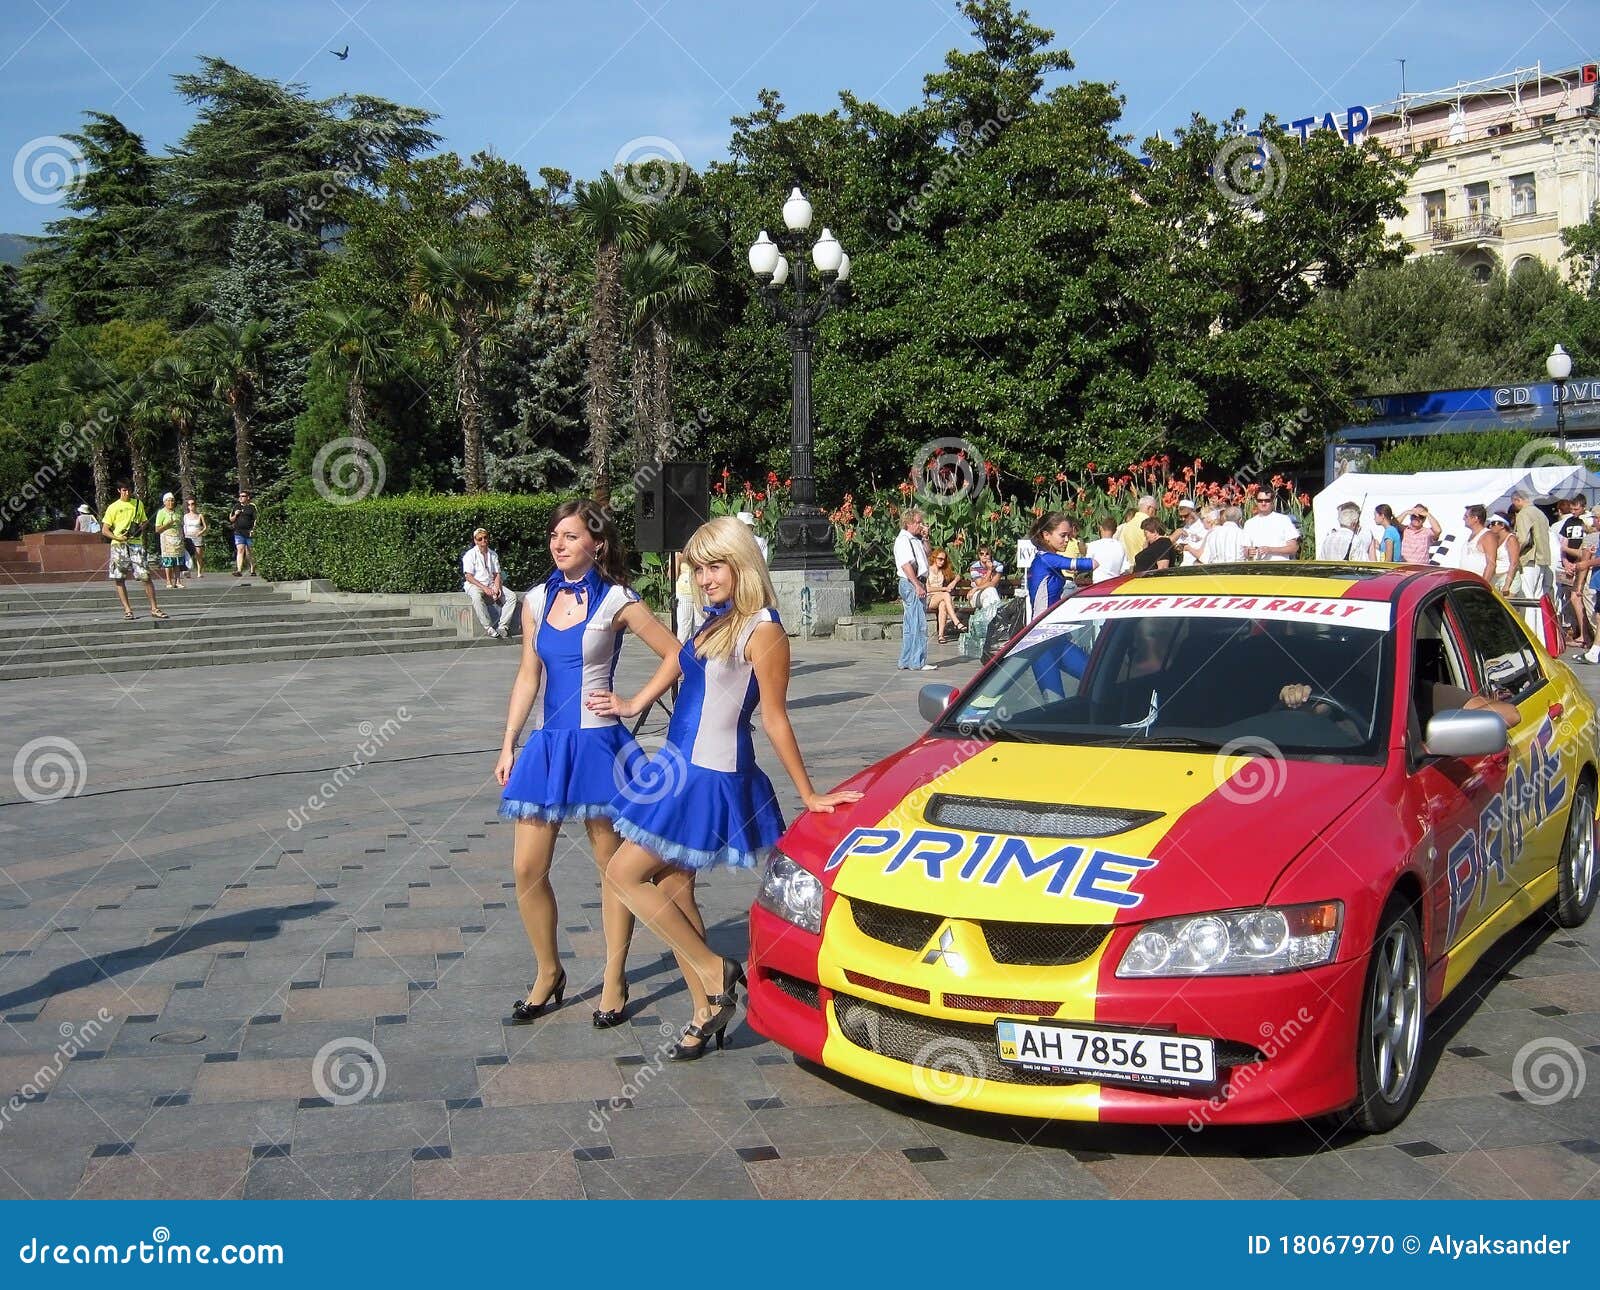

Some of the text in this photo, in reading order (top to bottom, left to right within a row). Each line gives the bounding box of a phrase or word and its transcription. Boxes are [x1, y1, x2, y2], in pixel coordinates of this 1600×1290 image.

[1494, 387, 1530, 406] CD
[1079, 597, 1365, 618] PRIME YALTA RALLY
[1443, 714, 1567, 956] PRIME
[824, 827, 1159, 908] PRIME
[1002, 1046, 1015, 1056] UA
[1020, 1029, 1204, 1073] AH 7856 EB
